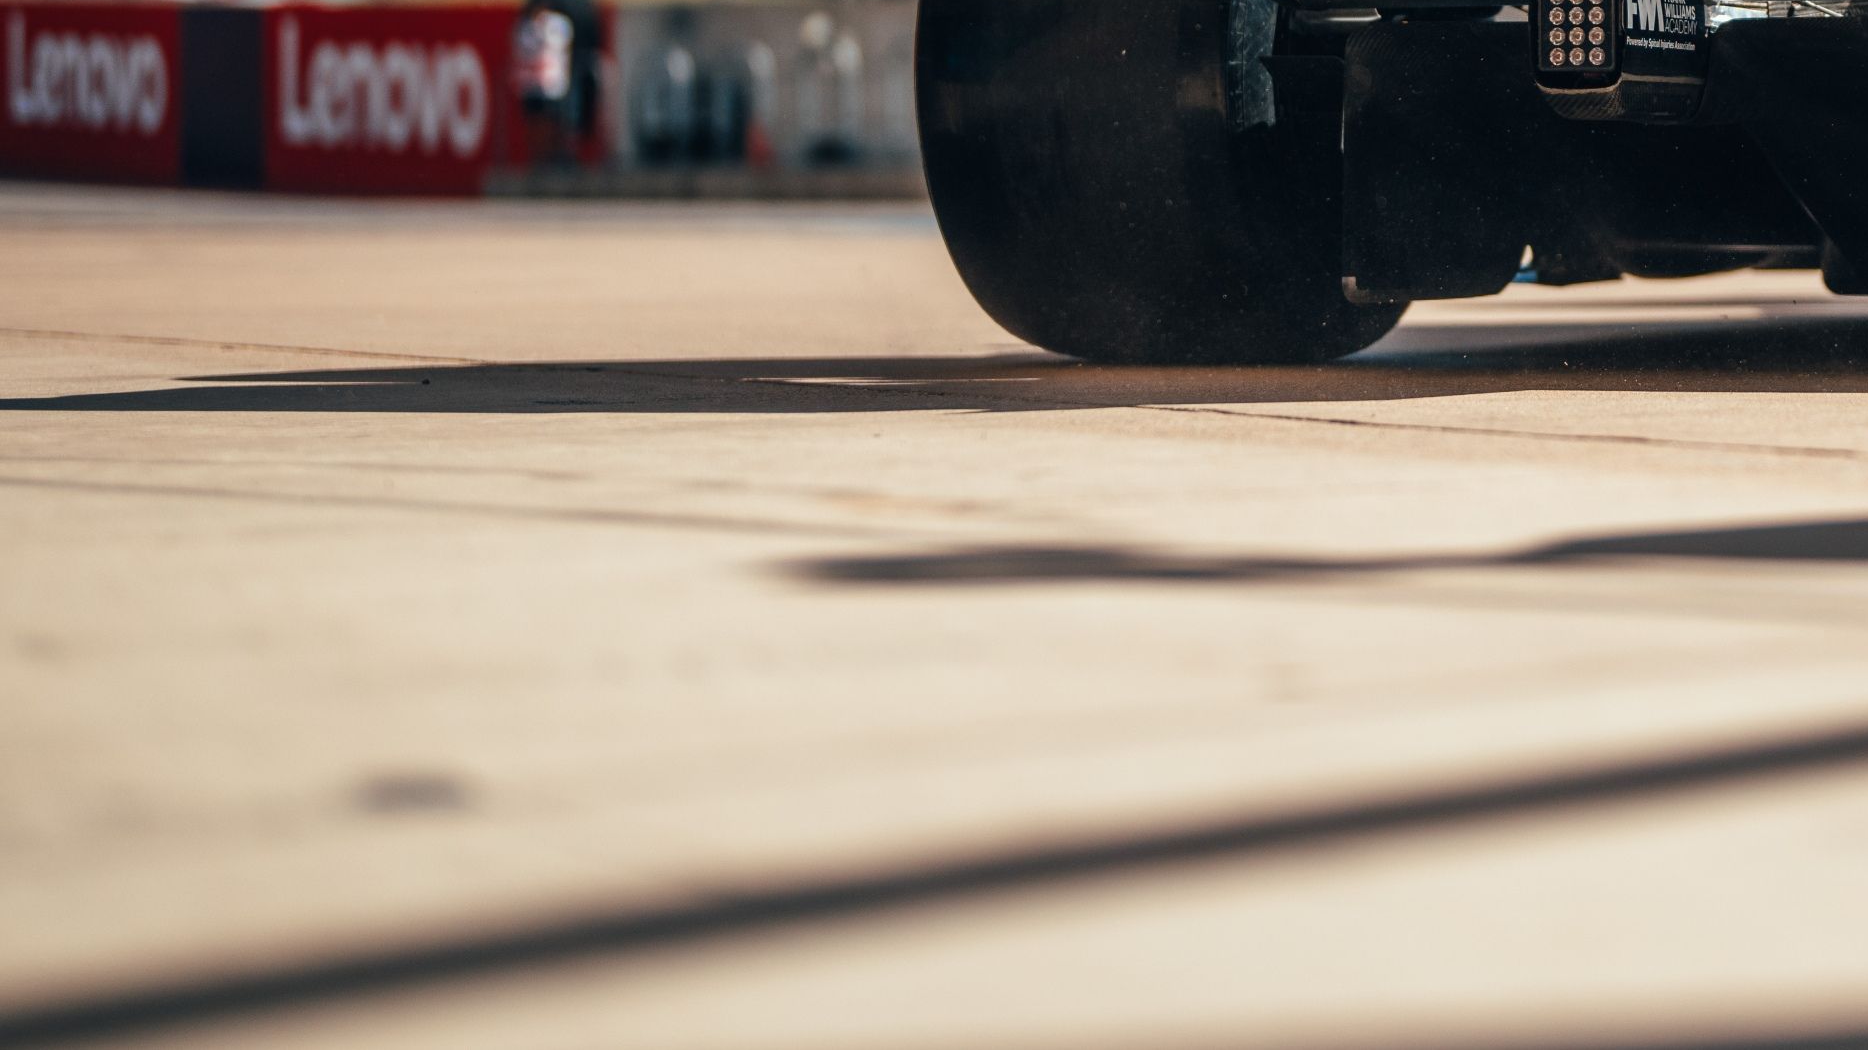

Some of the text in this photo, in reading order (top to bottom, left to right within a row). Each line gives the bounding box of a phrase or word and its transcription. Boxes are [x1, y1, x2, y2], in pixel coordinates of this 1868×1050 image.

[1664, 2, 1696, 20] WILLIAMS
[1664, 18, 1698, 35] ACADEMY
[8, 8, 168, 134] Lenovo
[278, 10, 488, 155] Lenovo
